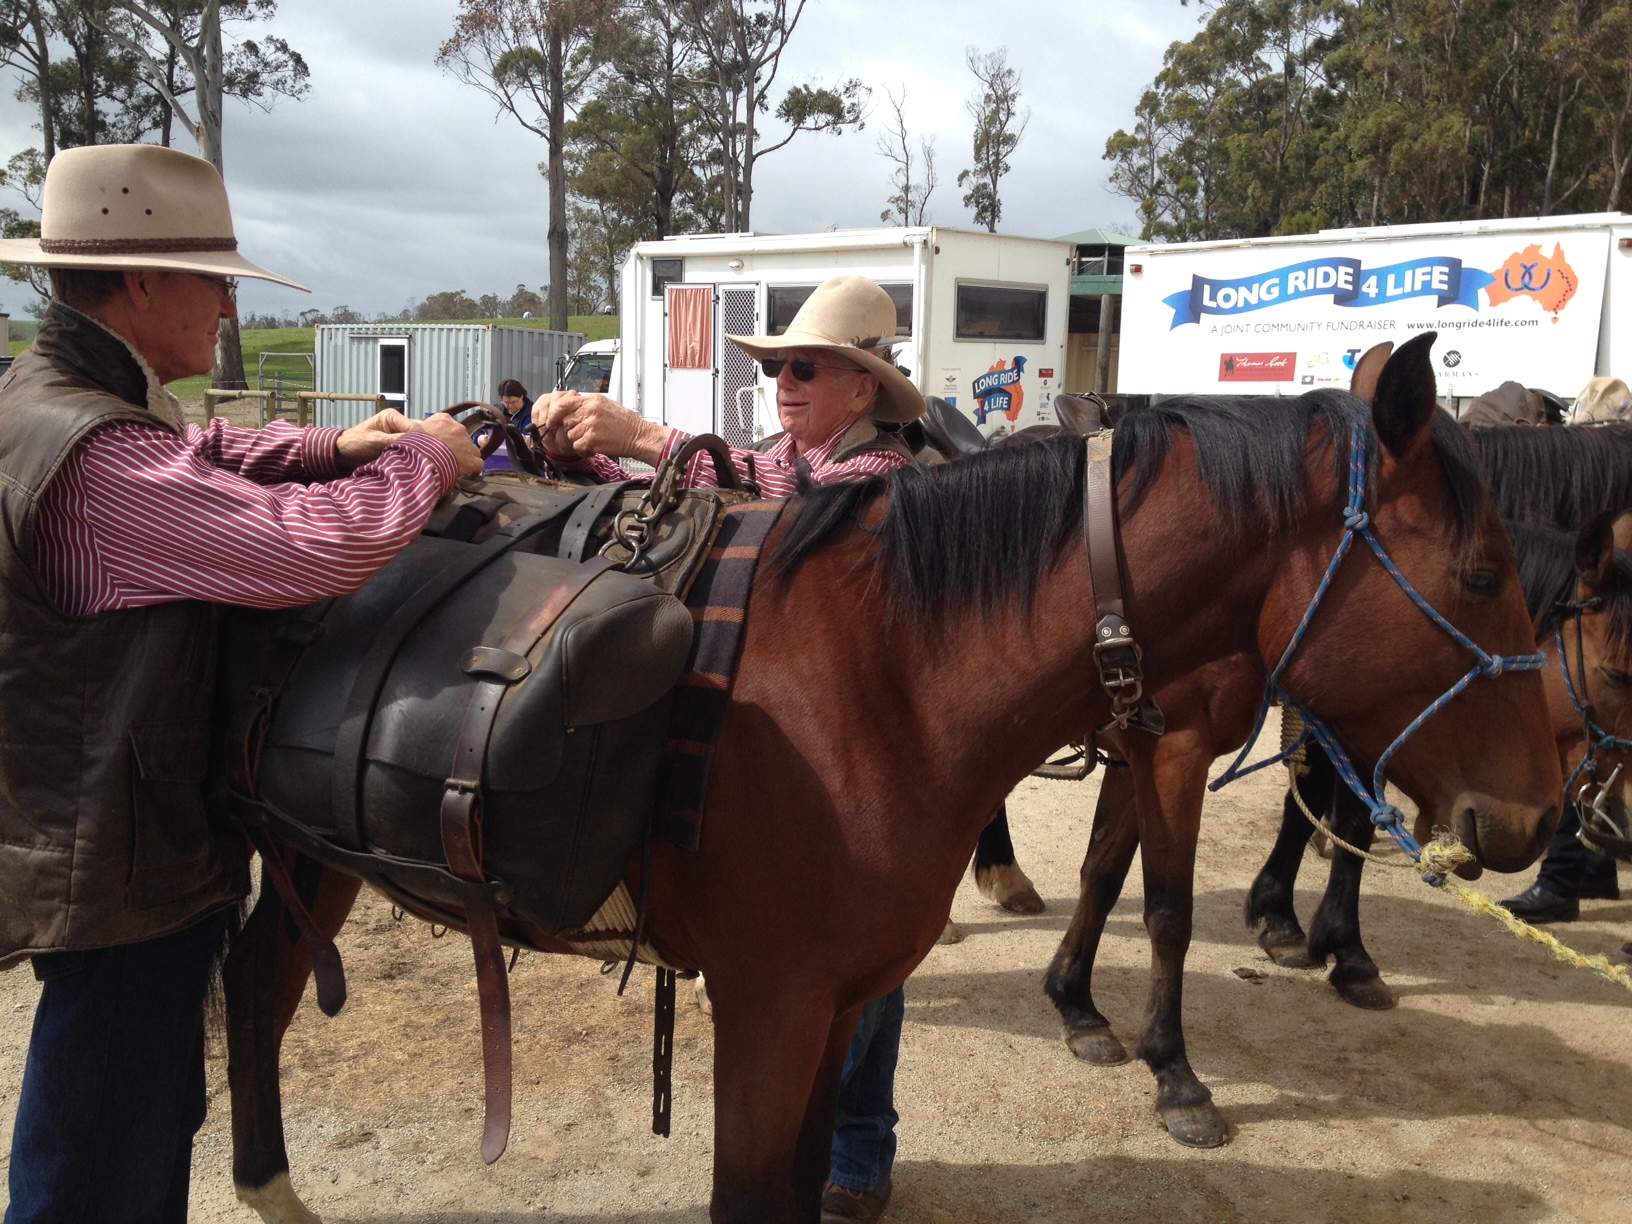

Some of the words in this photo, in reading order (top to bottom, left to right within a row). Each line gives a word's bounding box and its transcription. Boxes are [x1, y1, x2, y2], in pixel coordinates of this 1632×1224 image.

[1203, 277, 1280, 309] LONG
[1287, 265, 1354, 295] RIDE
[1361, 275, 1379, 298] 4
[1386, 265, 1450, 297] LIFE
[1211, 324, 1218, 333] A
[1220, 323, 1251, 336] JOINT
[1254, 321, 1323, 334] COMMUNITY
[1326, 319, 1396, 332] FUNDRAISER
[1407, 318, 1539, 330] www.longride4life.com
[975, 374, 998, 393] LONG
[1000, 368, 1019, 384] RIDE
[984, 399, 989, 411] 4
[991, 396, 1009, 409] LIFE
